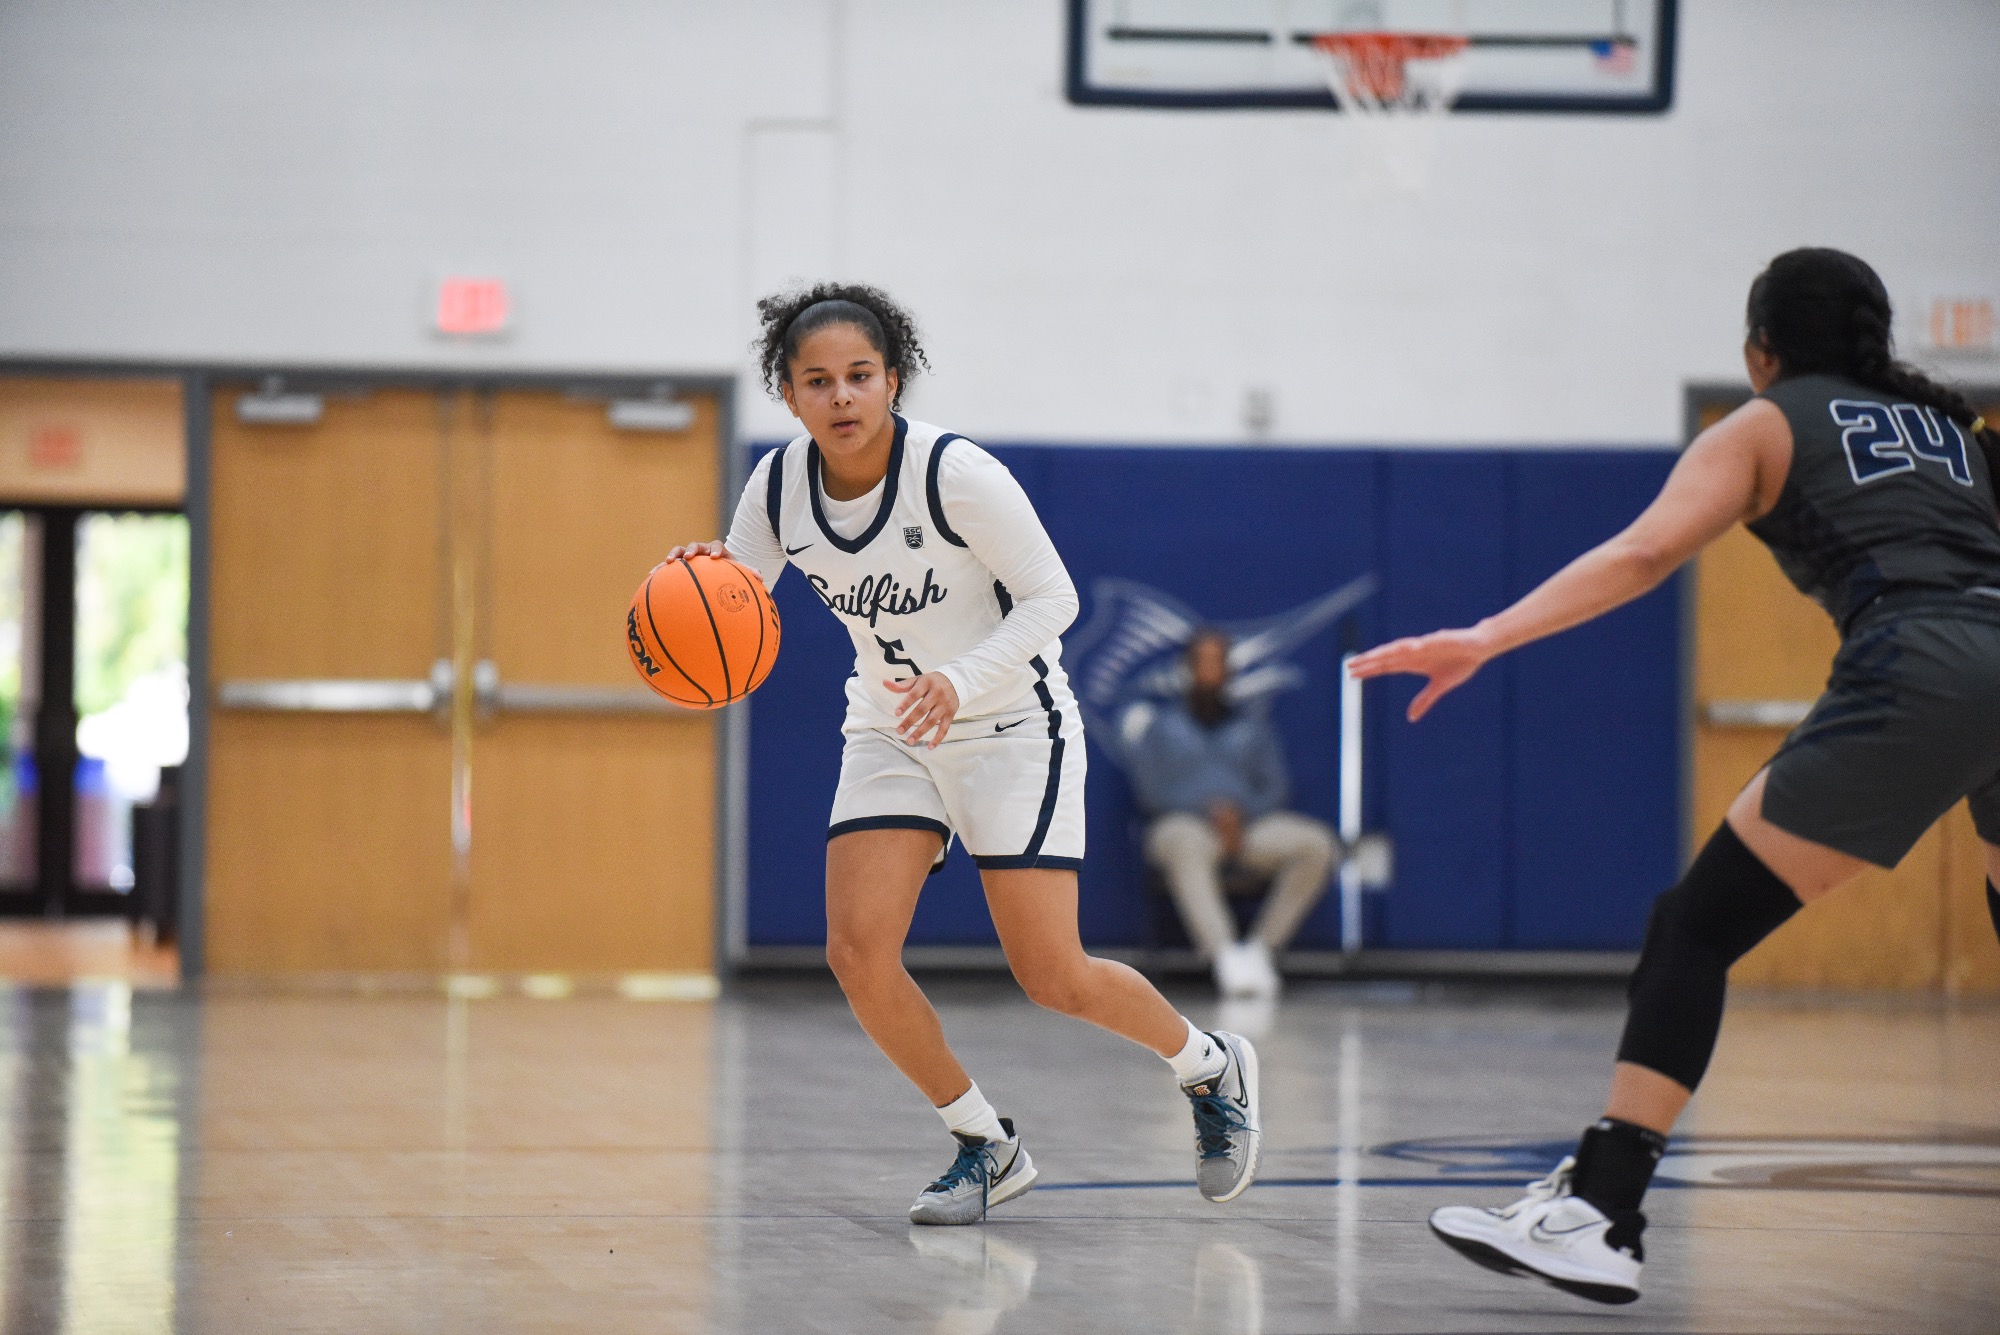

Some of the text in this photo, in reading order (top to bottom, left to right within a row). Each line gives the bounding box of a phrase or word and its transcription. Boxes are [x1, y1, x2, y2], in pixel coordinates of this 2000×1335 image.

[1829, 399, 1974, 487] 24
[807, 568, 948, 628] Sailfish
[627, 605, 661, 678] NCAA
[874, 633, 923, 683] 5
